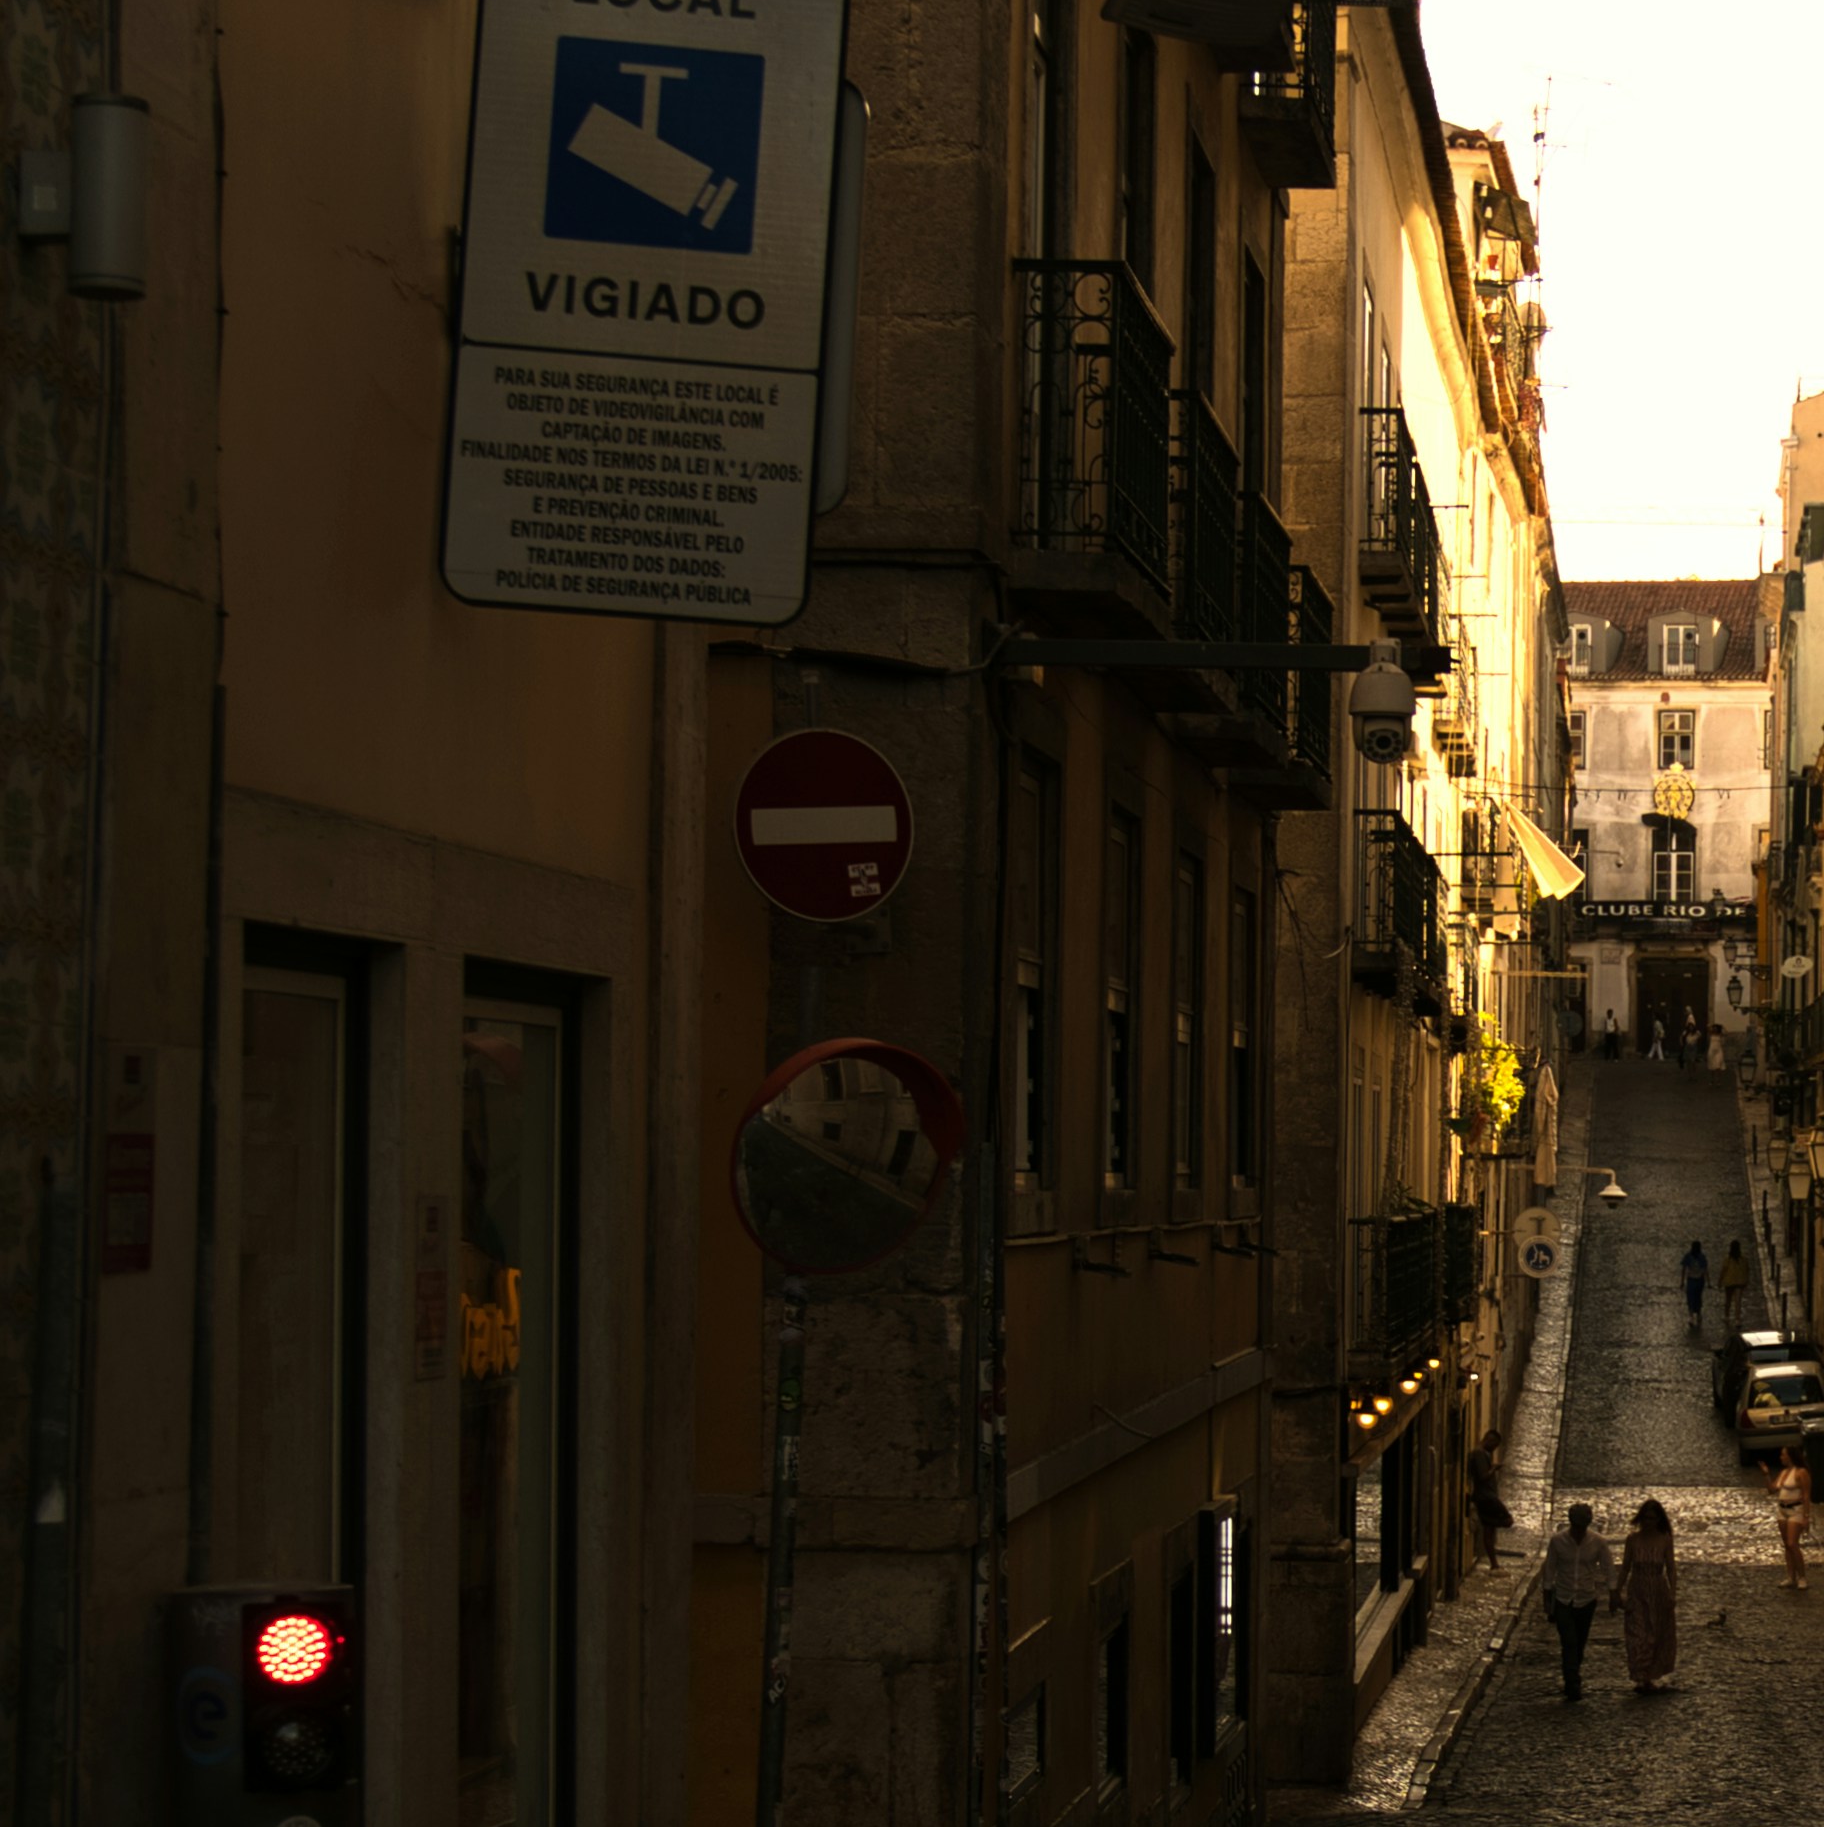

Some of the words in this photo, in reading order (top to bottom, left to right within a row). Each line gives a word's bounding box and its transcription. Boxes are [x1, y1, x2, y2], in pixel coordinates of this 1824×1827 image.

[526, 271, 765, 329] VIGIADO
[495, 366, 536, 386] PARA
[540, 370, 571, 389] SUA
[576, 373, 669, 400] SEGURANÇA
[675, 381, 712, 401] ESTE
[716, 385, 764, 405] LOCAL
[769, 384, 779, 406] É
[507, 392, 564, 414] OBJETO
[569, 397, 590, 416] DE
[593, 399, 725, 427] VIDEOVIGILÂNCIA
[729, 409, 764, 430] COM
[542, 420, 622, 447] CAPTAÇÃO
[627, 427, 647, 445] DE
[652, 429, 726, 452] IMAGENS.
[460, 439, 553, 463] FINALIDADE
[556, 447, 588, 466] NOS
[593, 450, 656, 472] TERMOS
[661, 454, 682, 473] DA
[686, 456, 710, 475] LEI
[740, 461, 803, 483] 1/2005:
[504, 468, 598, 496] SEGURANÇA
[603, 476, 624, 494] DE
[628, 478, 698, 500] PESSOAS
[703, 483, 713, 501] E
[717, 485, 758, 504] BENS
[533, 495, 544, 514] E
[548, 497, 640, 523] PREVENÇÃO
[645, 505, 724, 528] CRIMINAL.
[511, 519, 586, 542] ENTIDADE
[591, 525, 701, 551] RESPONSÁVEL
[705, 534, 744, 554] PELO
[527, 546, 628, 571] TRATAMENTO
[633, 554, 665, 574] DOS
[669, 557, 726, 579] DADOS:
[496, 568, 558, 591] POLÍCIA
[562, 575, 583, 593] DE
[586, 577, 681, 605] SEGURANÇA
[686, 580, 752, 606] PÚBLICA
[1581, 904, 1655, 917] CLUBE
[1663, 904, 1707, 918] RIO
